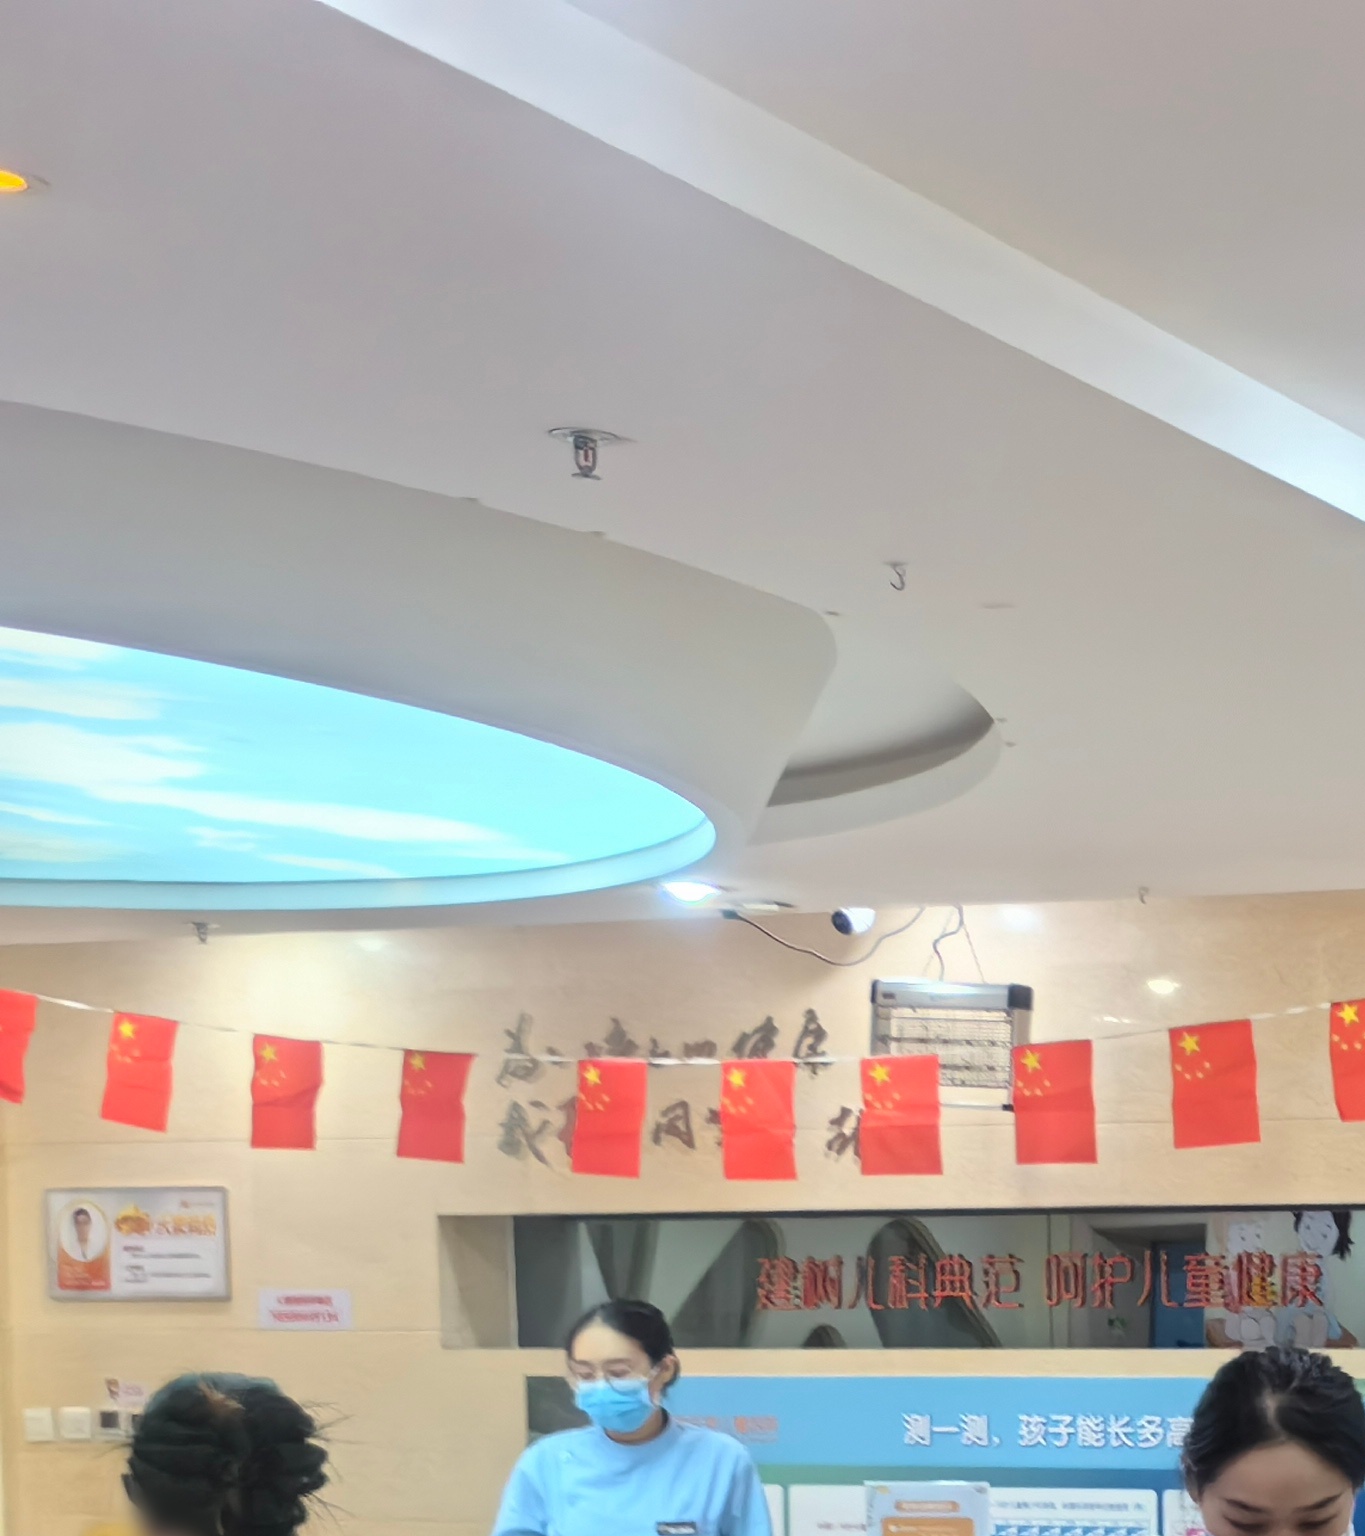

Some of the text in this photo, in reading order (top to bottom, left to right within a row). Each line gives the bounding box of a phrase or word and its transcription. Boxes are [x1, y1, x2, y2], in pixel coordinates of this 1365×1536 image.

[756, 1249, 1325, 1311] 建树儿科典范 呵护儿童健康
